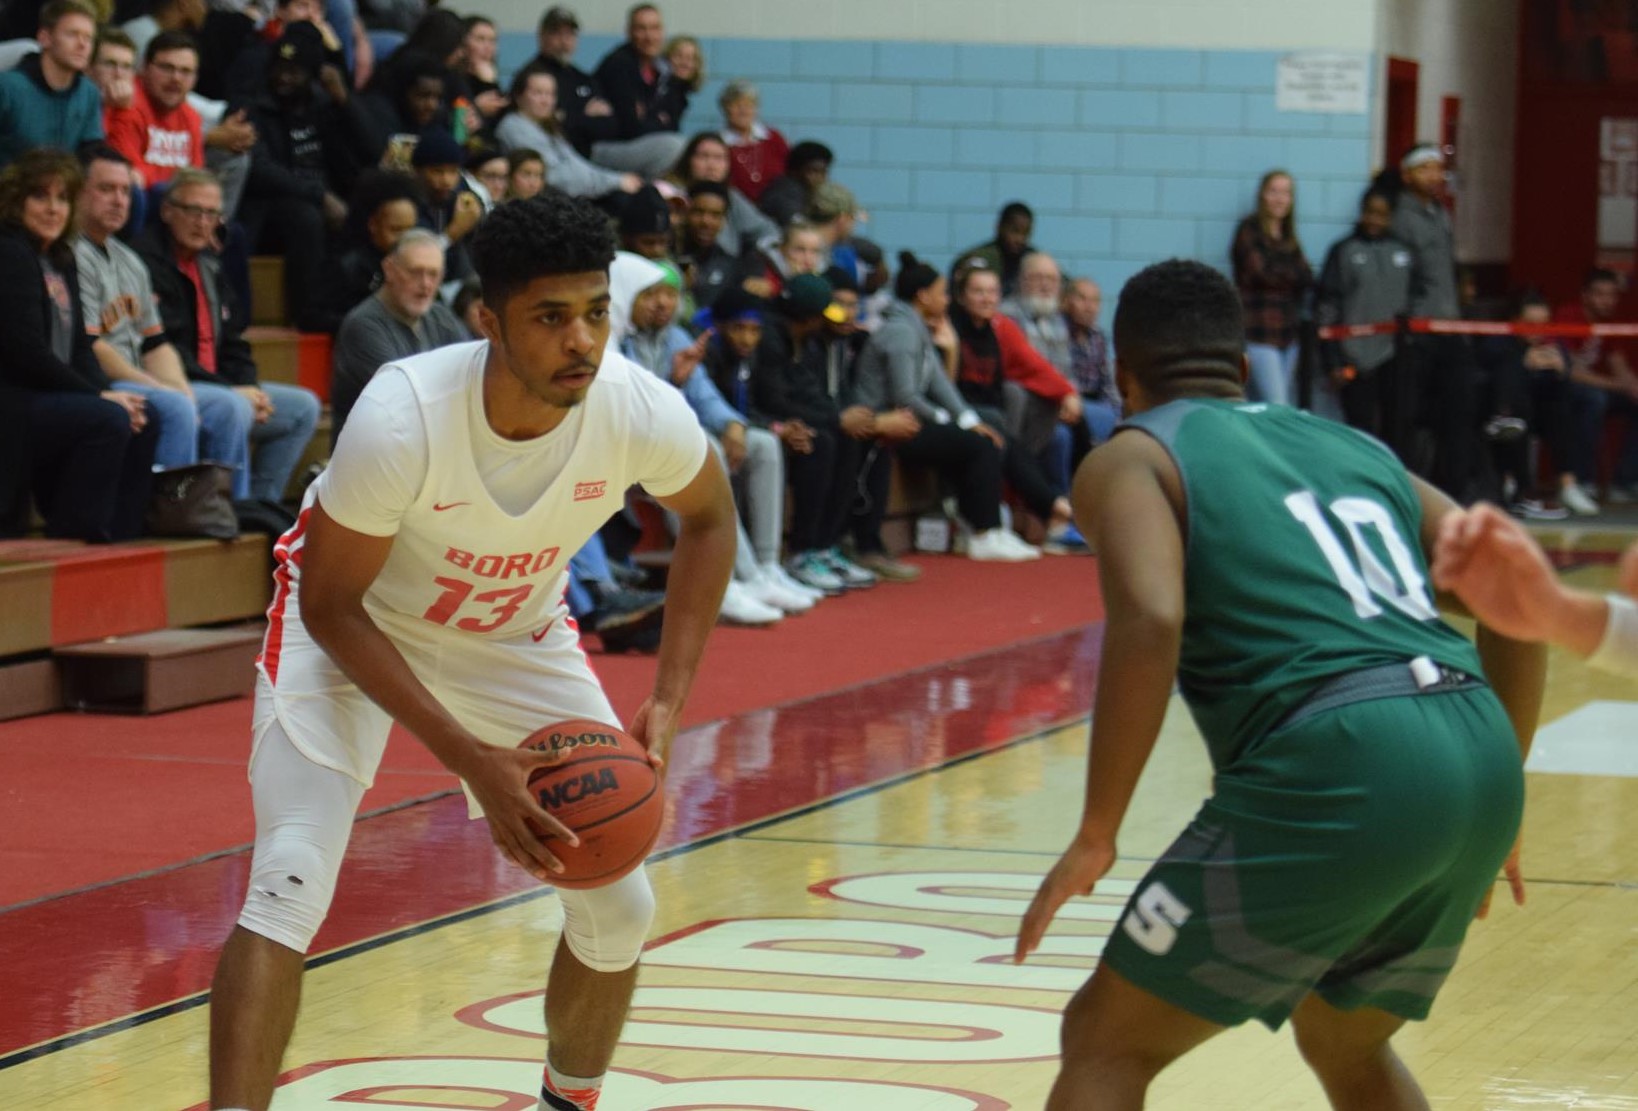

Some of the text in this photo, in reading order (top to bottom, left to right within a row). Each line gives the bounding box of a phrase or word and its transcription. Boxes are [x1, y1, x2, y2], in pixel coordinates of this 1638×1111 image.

[444, 546, 560, 579] BORO
[1284, 491, 1439, 621] 10
[423, 576, 534, 633] 13
[539, 767, 620, 810] NCAA
[1122, 881, 1193, 956] S
